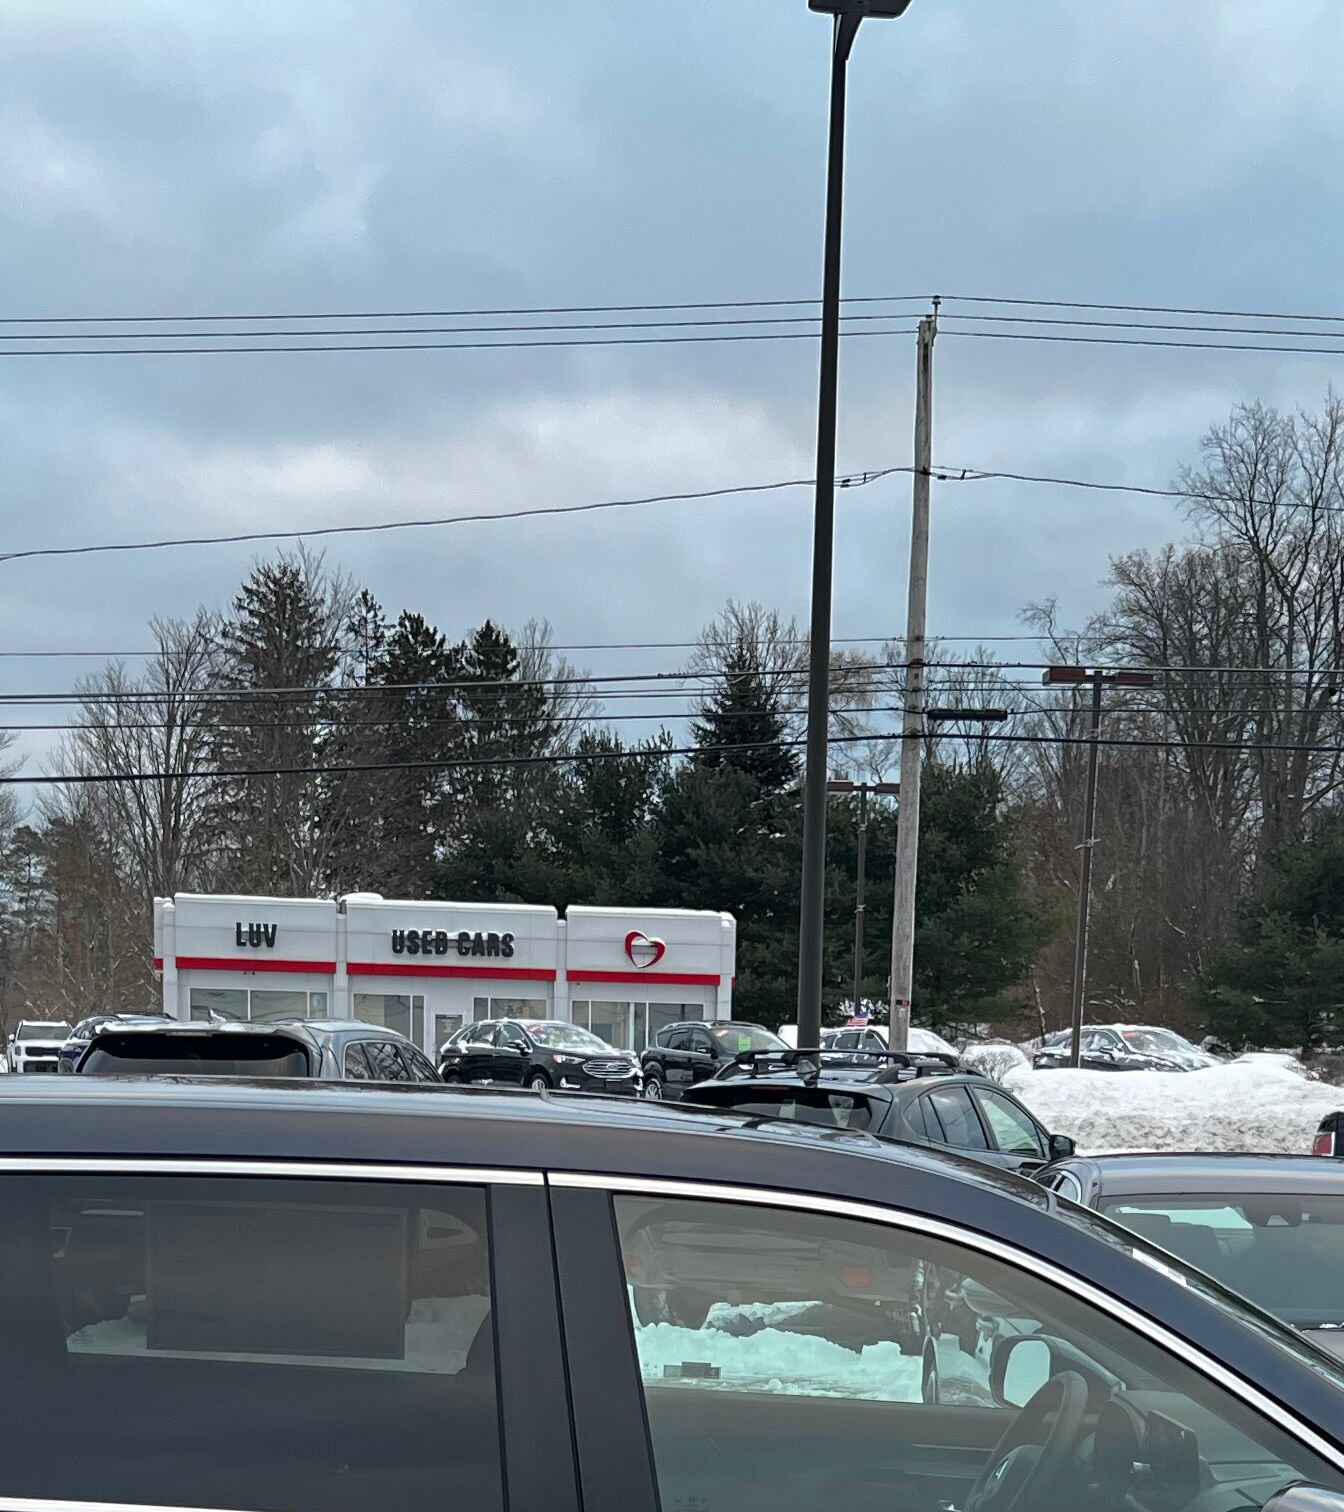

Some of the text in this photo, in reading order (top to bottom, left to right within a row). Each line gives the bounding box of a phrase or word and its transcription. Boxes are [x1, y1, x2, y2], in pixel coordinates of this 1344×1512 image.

[235, 921, 279, 948] LUV
[391, 928, 515, 958] USED CARS
